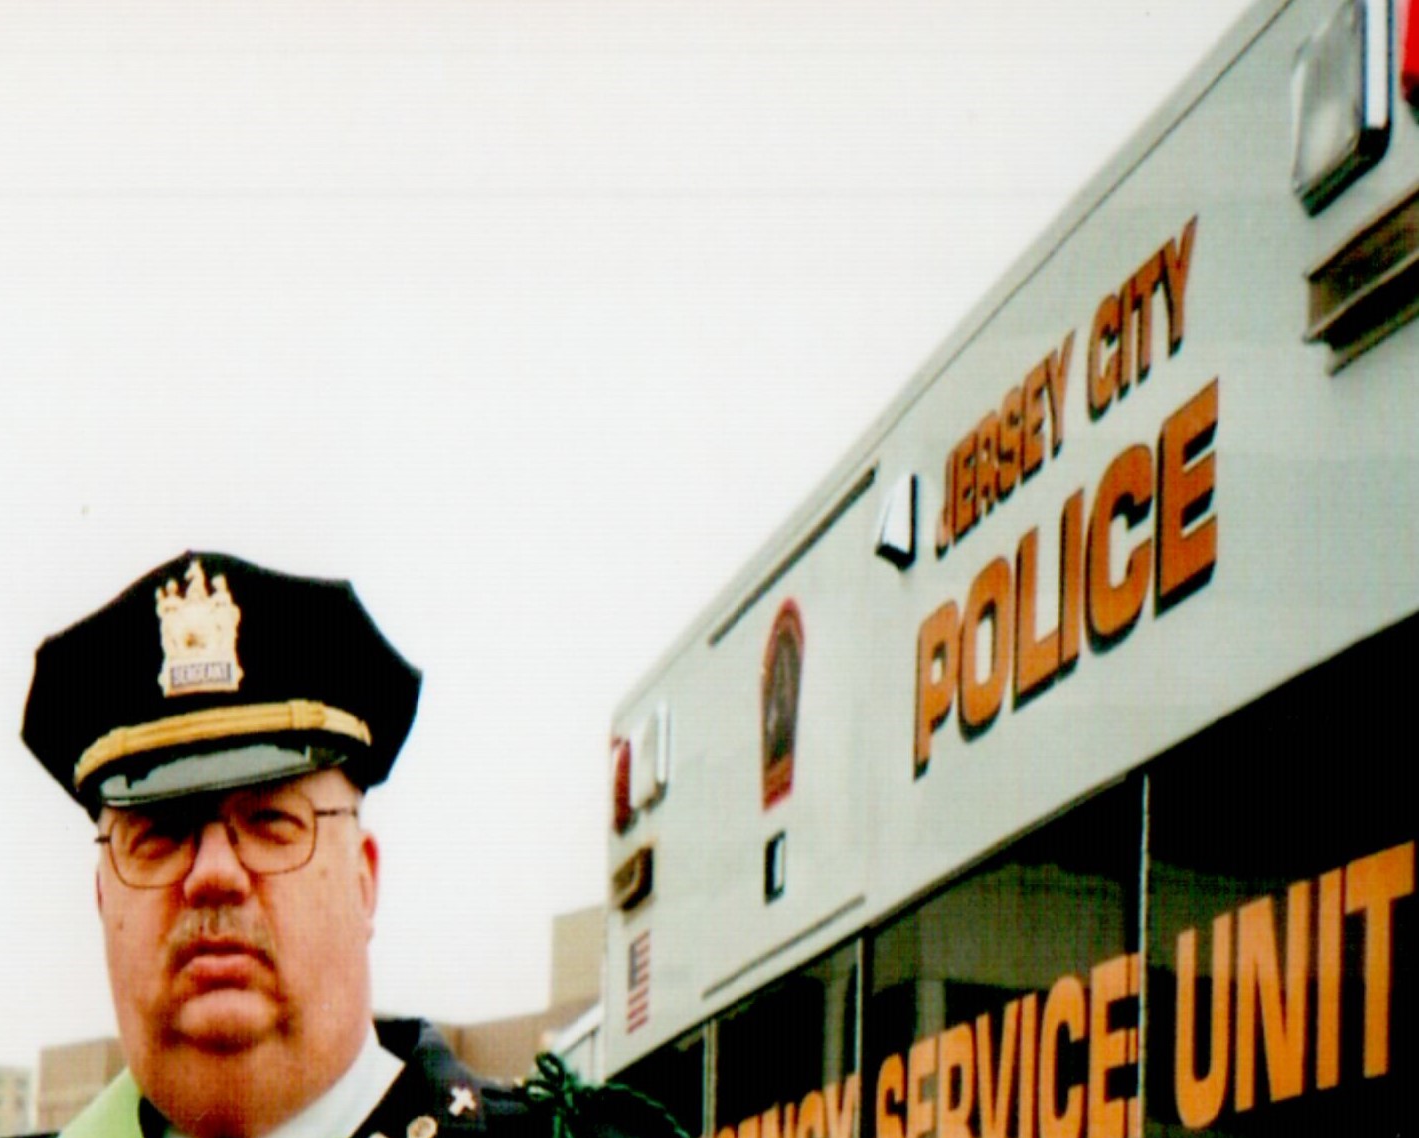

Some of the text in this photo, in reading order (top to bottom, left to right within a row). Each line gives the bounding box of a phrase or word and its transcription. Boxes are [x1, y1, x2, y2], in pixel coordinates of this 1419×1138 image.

[936, 213, 1198, 560] JERSEY CITY
[913, 375, 1219, 783] POLICE
[1175, 840, 1416, 1131] UNIT
